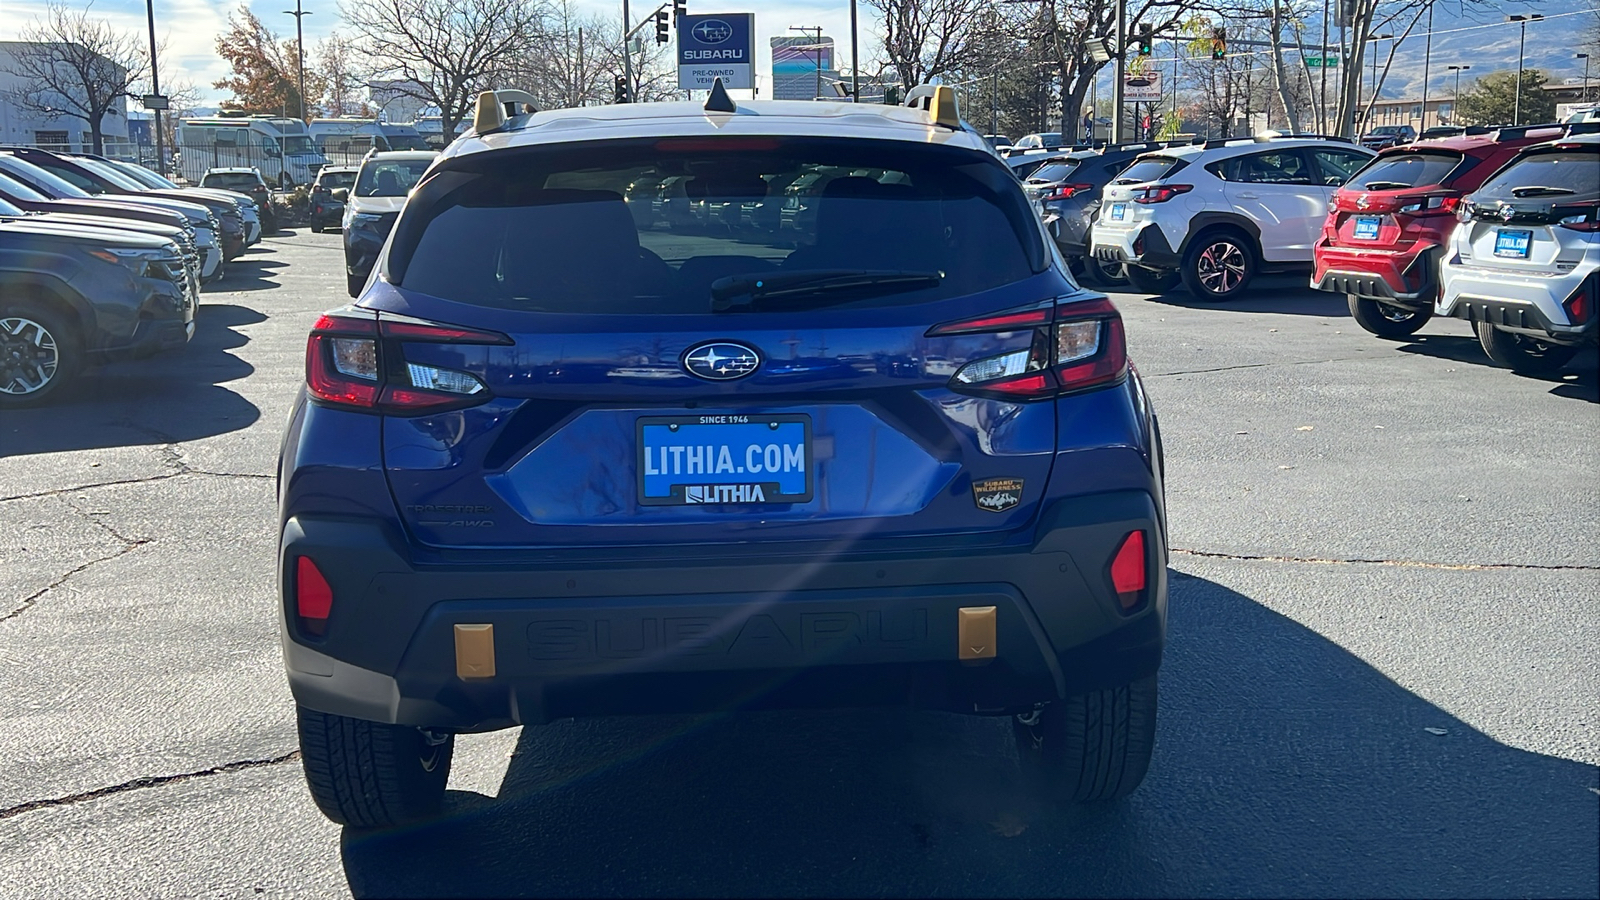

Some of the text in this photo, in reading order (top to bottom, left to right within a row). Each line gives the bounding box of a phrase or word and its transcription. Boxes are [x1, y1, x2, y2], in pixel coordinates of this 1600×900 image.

[684, 49, 743, 60] SUBARU
[692, 69, 735, 77] PRE-OWNED
[700, 416, 749, 424] SINCE 1946
[644, 443, 805, 476] LITHIA.COM
[975, 484, 1021, 493] WILDERNESS
[703, 484, 766, 504] LITHIA
[448, 520, 496, 528] AWD
[526, 608, 928, 661] SUBARU
